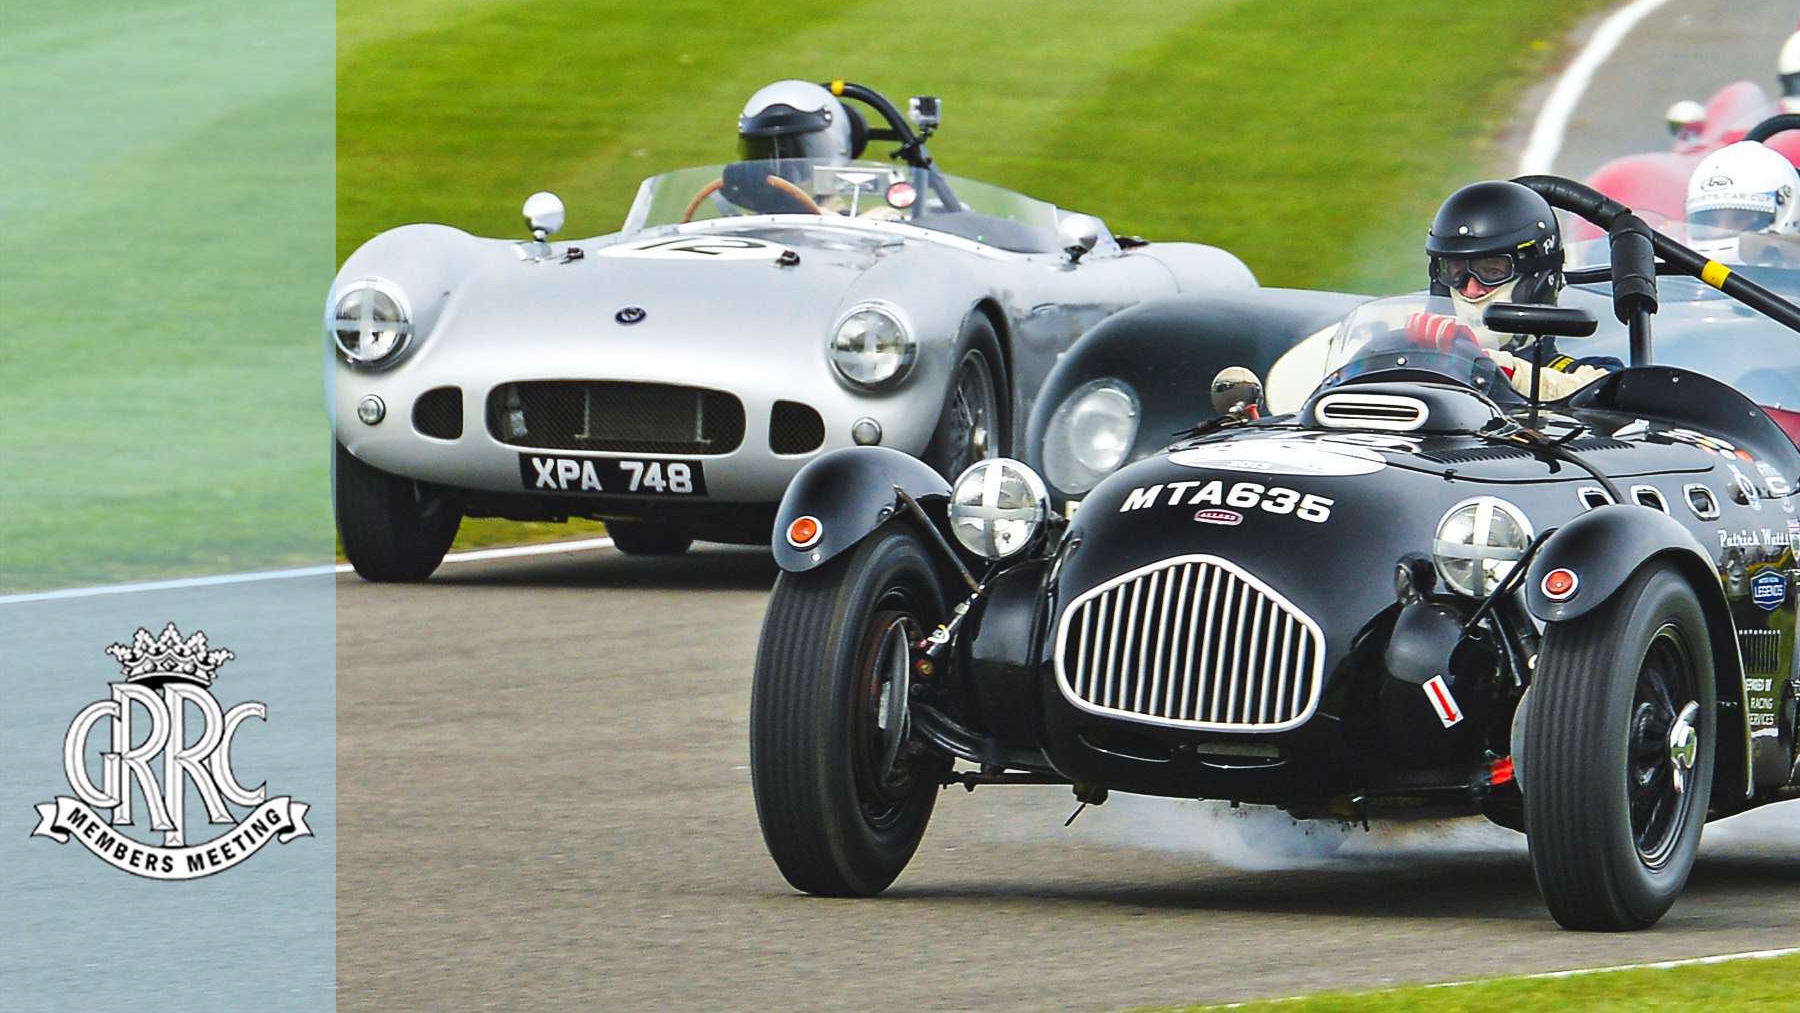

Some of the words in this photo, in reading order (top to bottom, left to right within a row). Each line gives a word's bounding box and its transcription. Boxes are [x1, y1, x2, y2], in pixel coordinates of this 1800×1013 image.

[532, 457, 604, 492] XPA
[619, 461, 693, 493] 748
[1120, 481, 1335, 523] MTA635
[1717, 529, 1760, 547] Patrick
